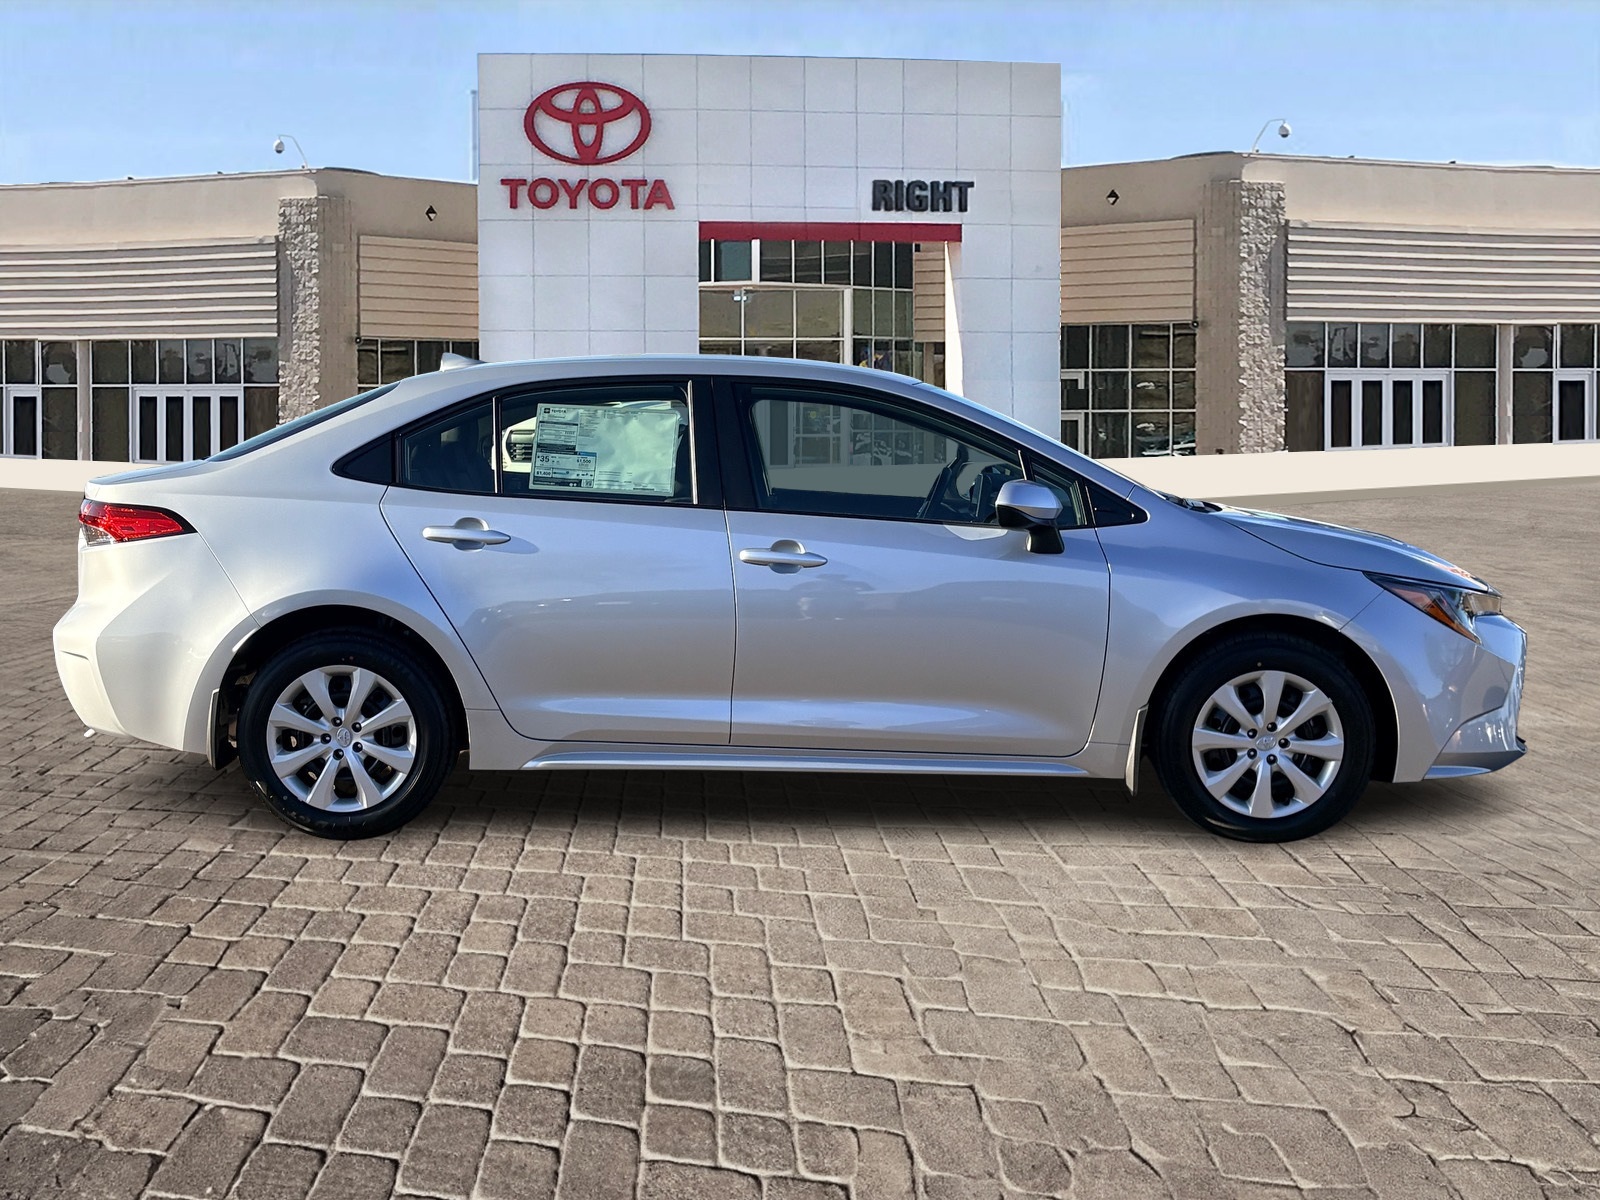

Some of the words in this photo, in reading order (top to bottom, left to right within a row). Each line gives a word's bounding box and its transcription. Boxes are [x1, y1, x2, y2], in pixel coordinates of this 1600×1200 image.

[501, 179, 675, 210] TOYOTA
[871, 179, 975, 213] RIGHT
[540, 455, 550, 463] 35
